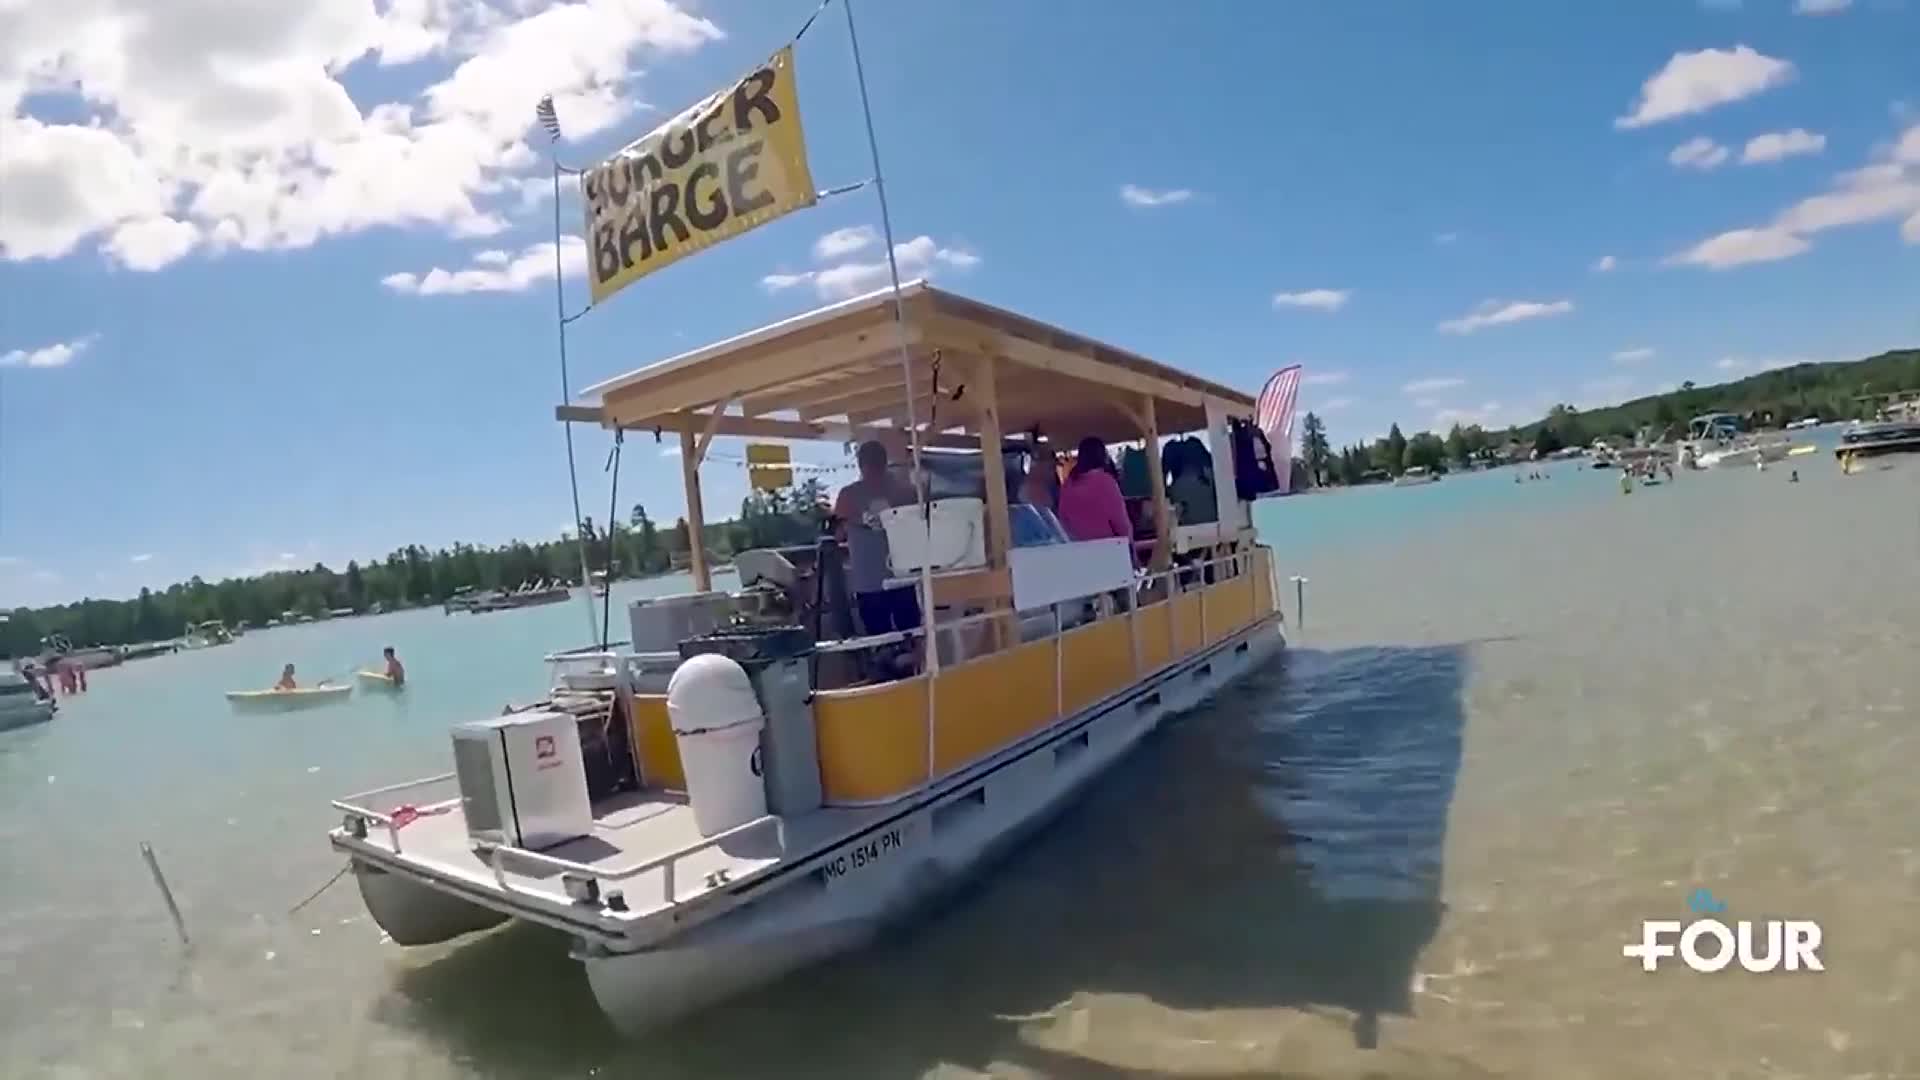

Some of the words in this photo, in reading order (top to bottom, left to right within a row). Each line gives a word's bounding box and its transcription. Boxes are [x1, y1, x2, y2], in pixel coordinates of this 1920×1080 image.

[594, 140, 776, 284] BARGE
[823, 856, 847, 881] MC
[850, 841, 879, 869] 1514
[881, 831, 902, 854] PN
